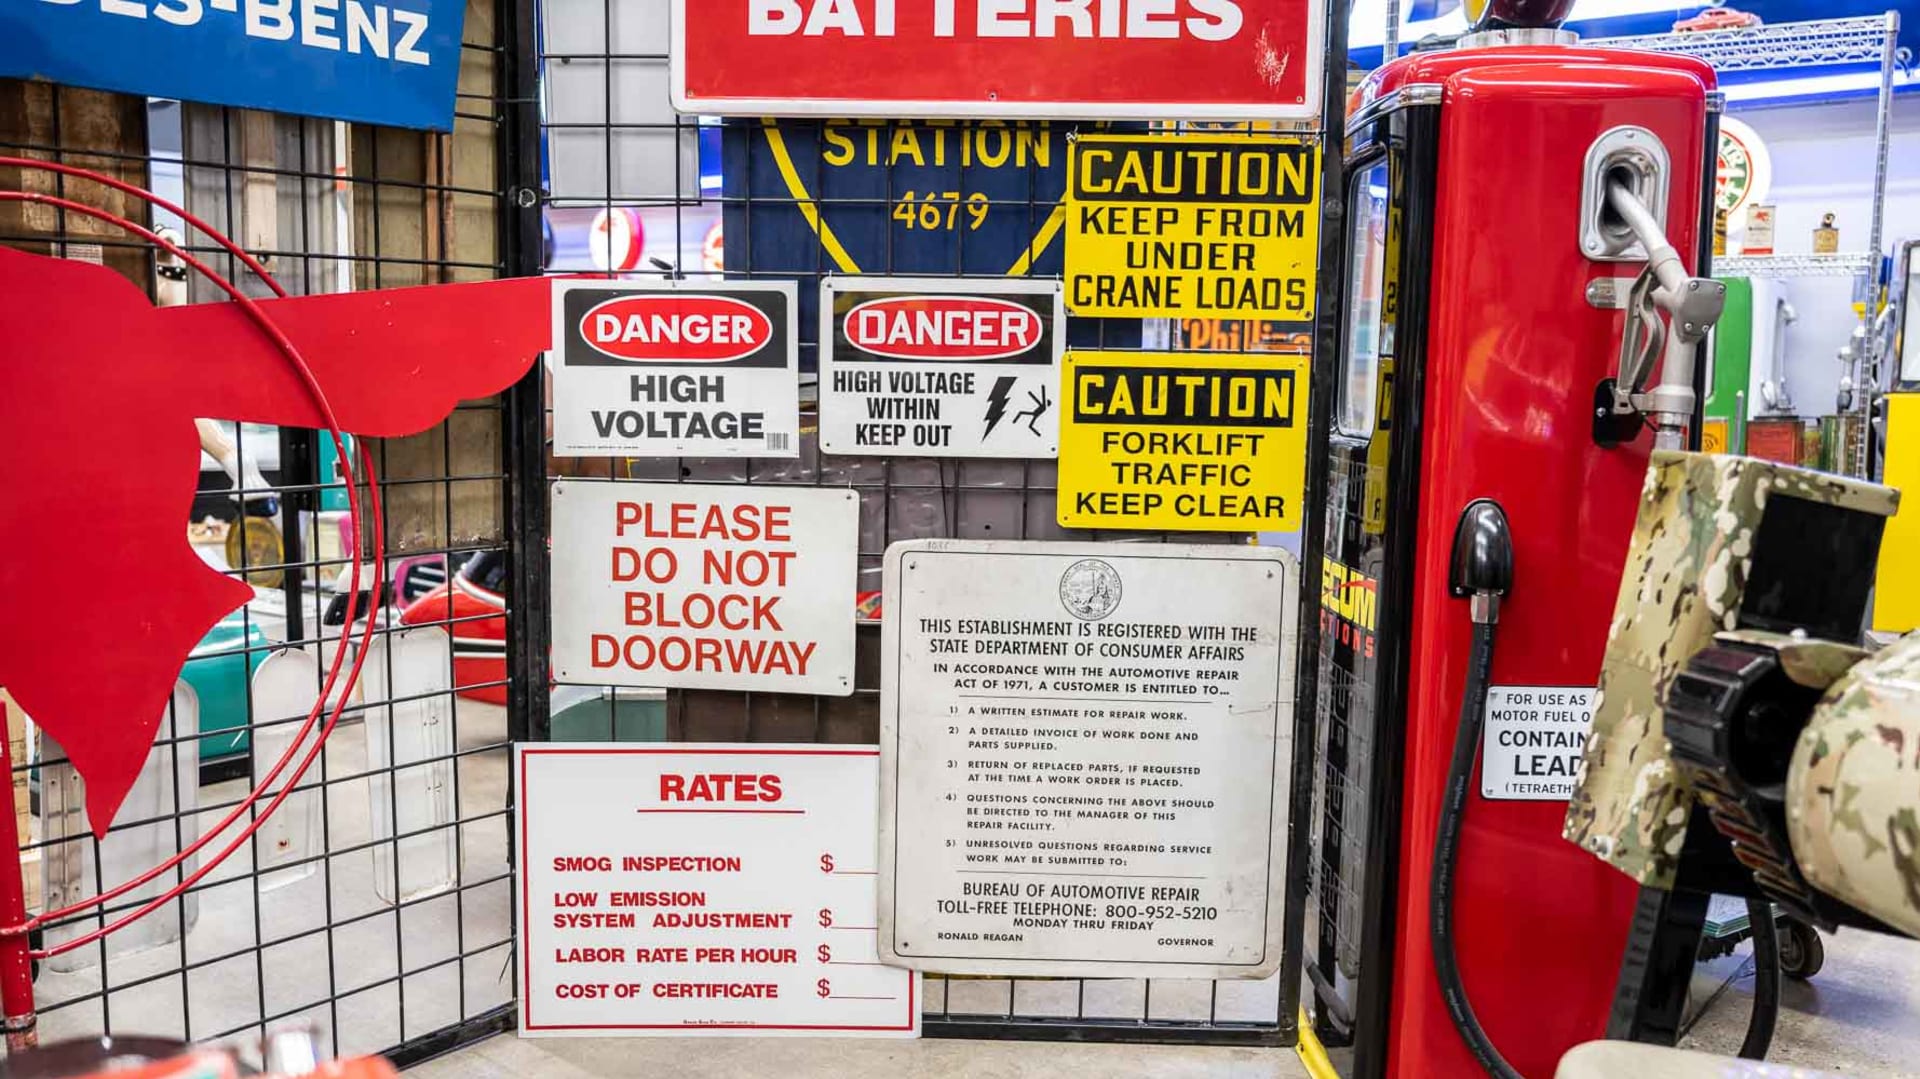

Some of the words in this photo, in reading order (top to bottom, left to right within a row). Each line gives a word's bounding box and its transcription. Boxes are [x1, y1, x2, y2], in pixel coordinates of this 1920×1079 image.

[822, 118, 1050, 168] STATION
[1081, 150, 1306, 195] CAUTION
[894, 191, 988, 229] 4679
[1081, 207, 1178, 235] KEEP
[1196, 209, 1303, 237] FROM
[1127, 242, 1255, 270] UNDER
[1072, 275, 1182, 310] CRANE
[1197, 277, 1307, 311] LOADS
[596, 314, 755, 345] DANGER
[858, 308, 1030, 350] DANGER
[631, 376, 723, 402] HIGH
[833, 371, 883, 393] HIGH
[887, 372, 975, 395] VOLTAGE
[1079, 375, 1290, 417] CAUTION
[867, 398, 939, 419] WITHIN
[592, 411, 763, 439] VOLTAGE
[856, 424, 905, 445] KEEP
[914, 425, 951, 446] OUT
[1103, 432, 1264, 456] FORKLIFT
[1112, 463, 1250, 486] TRAFFIC
[1077, 493, 1162, 515] KEEP
[1175, 495, 1284, 517] CLEAR
[617, 502, 790, 541] PLEASE
[612, 547, 677, 583] DO
[704, 550, 796, 586] NOT
[1321, 556, 1377, 632] ECUM
[625, 592, 782, 631] BLOCK
[919, 618, 953, 635] THIS
[957, 619, 1074, 637] ESTABLISHMENT
[1077, 622, 1092, 638] IS
[1097, 622, 1182, 641] REGISTERED
[1187, 625, 1226, 642] WITH
[1230, 625, 1258, 643] THE
[592, 634, 816, 675] DOORWAY
[929, 637, 969, 654] STATE
[974, 639, 1070, 657] DEPARTMENT
[1073, 641, 1095, 657] OF
[1099, 641, 1183, 660] CONSUMER
[1186, 642, 1245, 662] AFFAIRS
[933, 662, 948, 674] IN
[953, 663, 1039, 676] ACCORDANCE
[1043, 665, 1077, 677] WITH
[1080, 666, 1104, 678] THE
[1107, 667, 1191, 680] AUTOMOTIVE
[1195, 669, 1240, 681] REPAIR
[953, 678, 977, 689] ACT
[981, 678, 999, 690] OF
[1003, 679, 1033, 692] 1971,
[1037, 680, 1048, 691] A
[1052, 680, 1120, 693] CUSTOMER
[1124, 682, 1137, 694] IS
[1141, 683, 1198, 695] ENTITLED
[1506, 693, 1532, 705] FOR
[1538, 694, 1564, 705] USE
[1569, 694, 1586, 706] AS
[948, 705, 960, 716] 1)
[967, 705, 977, 716] A
[979, 706, 1029, 718] WRITTEN
[1030, 707, 1080, 719] ESTIMATE
[1083, 709, 1106, 719] FOR
[1108, 710, 1147, 721] REPAIR
[1149, 710, 1188, 721] WORK.
[1491, 710, 1538, 722] MOTOR
[1544, 711, 1576, 722] FUEL
[947, 725, 960, 735] 2)
[968, 726, 977, 736] A
[981, 726, 1029, 738] DETAILED
[1033, 727, 1079, 739] INVOICE
[1082, 728, 1098, 739] OF
[1101, 728, 1136, 740] WORK
[1139, 730, 1172, 741] DONE
[1174, 731, 1199, 741] AND
[1498, 730, 1586, 748] CONTAIN
[967, 738, 1000, 750] PARTS
[1002, 740, 1058, 753] SUPPLIED.
[947, 759, 958, 769] 3)
[967, 759, 1009, 770] RETURN
[1012, 761, 1029, 770] OF
[1031, 760, 1085, 773] REPLACED
[1087, 762, 1124, 775] PARTS,
[1127, 764, 1139, 775] IF
[1141, 764, 1202, 777] REQUESTED
[660, 774, 782, 802] RATES
[967, 773, 981, 783] AT
[984, 773, 1004, 783] THE
[1007, 773, 1033, 785] TIME
[1035, 774, 1044, 785] A
[1047, 774, 1081, 785] WORK
[1084, 775, 1121, 786] ORDER
[1125, 777, 1136, 787] IS
[1139, 777, 1184, 788] PLACED.
[945, 792, 957, 802] 4)
[966, 792, 1029, 804] QUESTIONS
[1031, 795, 1105, 807] CONCERNING
[1107, 796, 1127, 807] THE
[1130, 797, 1168, 808] ABOVE
[1170, 798, 1215, 809] SHOULD
[966, 806, 980, 816] BE
[982, 806, 1033, 818] DIRECTED
[1034, 807, 1052, 820] TO
[1053, 808, 1073, 821] THE
[1076, 809, 1130, 821] MANAGER
[1133, 811, 1148, 821] OF
[1152, 811, 1176, 821] THIS
[966, 820, 1004, 830] REPAIR
[1007, 821, 1056, 832] FACILITY.
[945, 839, 957, 848] 5)
[965, 839, 1034, 850] UNRESOLVED
[1037, 841, 1100, 854] QUESTIONS
[1102, 842, 1166, 855] REGARDING
[1169, 844, 1212, 855] SERVICE
[553, 856, 612, 872] SMOG
[622, 856, 741, 872] INSPECTION
[820, 854, 834, 874] $
[965, 854, 999, 864] WORK
[1003, 854, 1027, 864] MAY
[1031, 855, 1044, 864] BE
[1047, 855, 1106, 867] SUBMITTED
[1108, 856, 1128, 867] TO:
[554, 892, 598, 908] LOW
[609, 891, 706, 907] EMISSION
[962, 881, 1020, 898] BUREAU
[1025, 883, 1046, 898] OF
[1049, 883, 1146, 901] AUTOMOTIVE
[1150, 885, 1201, 902] REPAIR
[553, 913, 636, 929] SYSTEM
[652, 912, 792, 929] ADJUSTMENT
[818, 909, 833, 928] $
[936, 899, 1009, 916] TOLL-FREE
[1012, 901, 1098, 919] TELEPHONE:
[1104, 904, 1218, 922] 800-952-5210
[1012, 917, 1069, 929] MONDAY
[1072, 919, 1106, 930] THRU
[1110, 919, 1156, 932] FRIDAY
[937, 931, 980, 941] RONALD
[982, 932, 1024, 943] REAGAN
[1156, 935, 1215, 947] GOVERNOR
[555, 947, 625, 963] LABOR
[636, 947, 688, 964] RATE
[695, 947, 735, 963] PER
[740, 948, 797, 964] HOUR
[817, 944, 831, 964] $
[555, 983, 610, 999] COST
[613, 983, 641, 999] OF
[652, 982, 778, 999] CERTIFICATE
[816, 978, 831, 999] $
